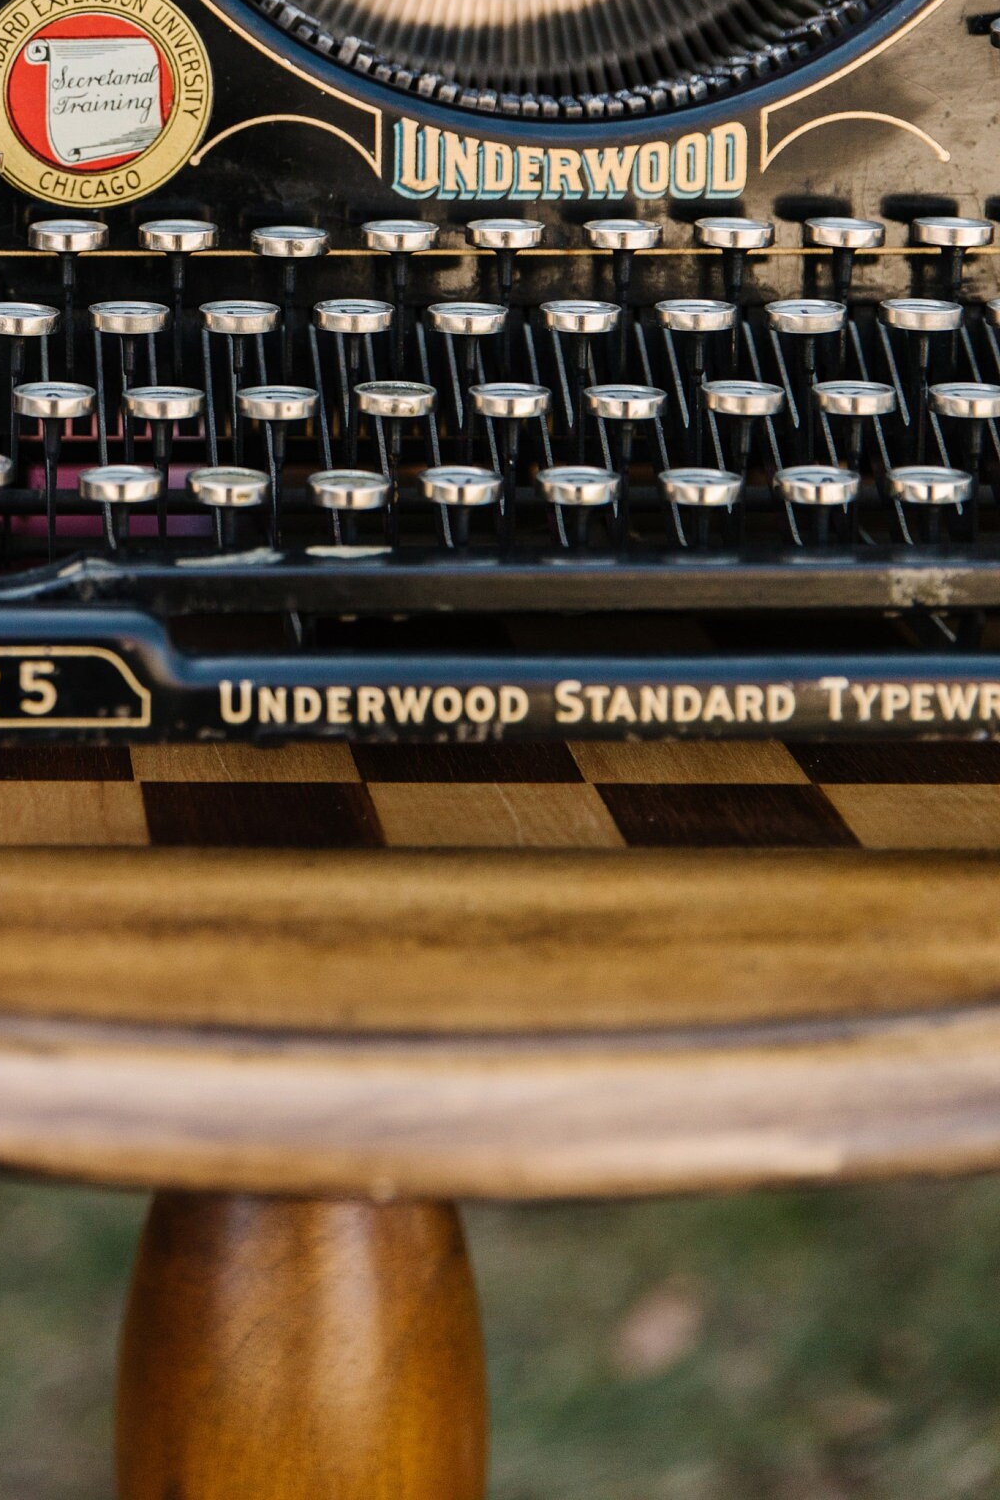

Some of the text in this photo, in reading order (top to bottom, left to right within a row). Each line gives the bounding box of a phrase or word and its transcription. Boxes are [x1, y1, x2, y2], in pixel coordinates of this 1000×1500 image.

[52, 63, 160, 91] Secretarial
[152, 5, 205, 120] UNIVERSITY
[52, 92, 154, 124] Training
[391, 116, 748, 201] UNDERWOOD
[39, 169, 142, 200] CHICAGO
[19, 660, 58, 715] 5
[217, 678, 530, 726] UNDERWOOD
[554, 678, 797, 724] STANDARD
